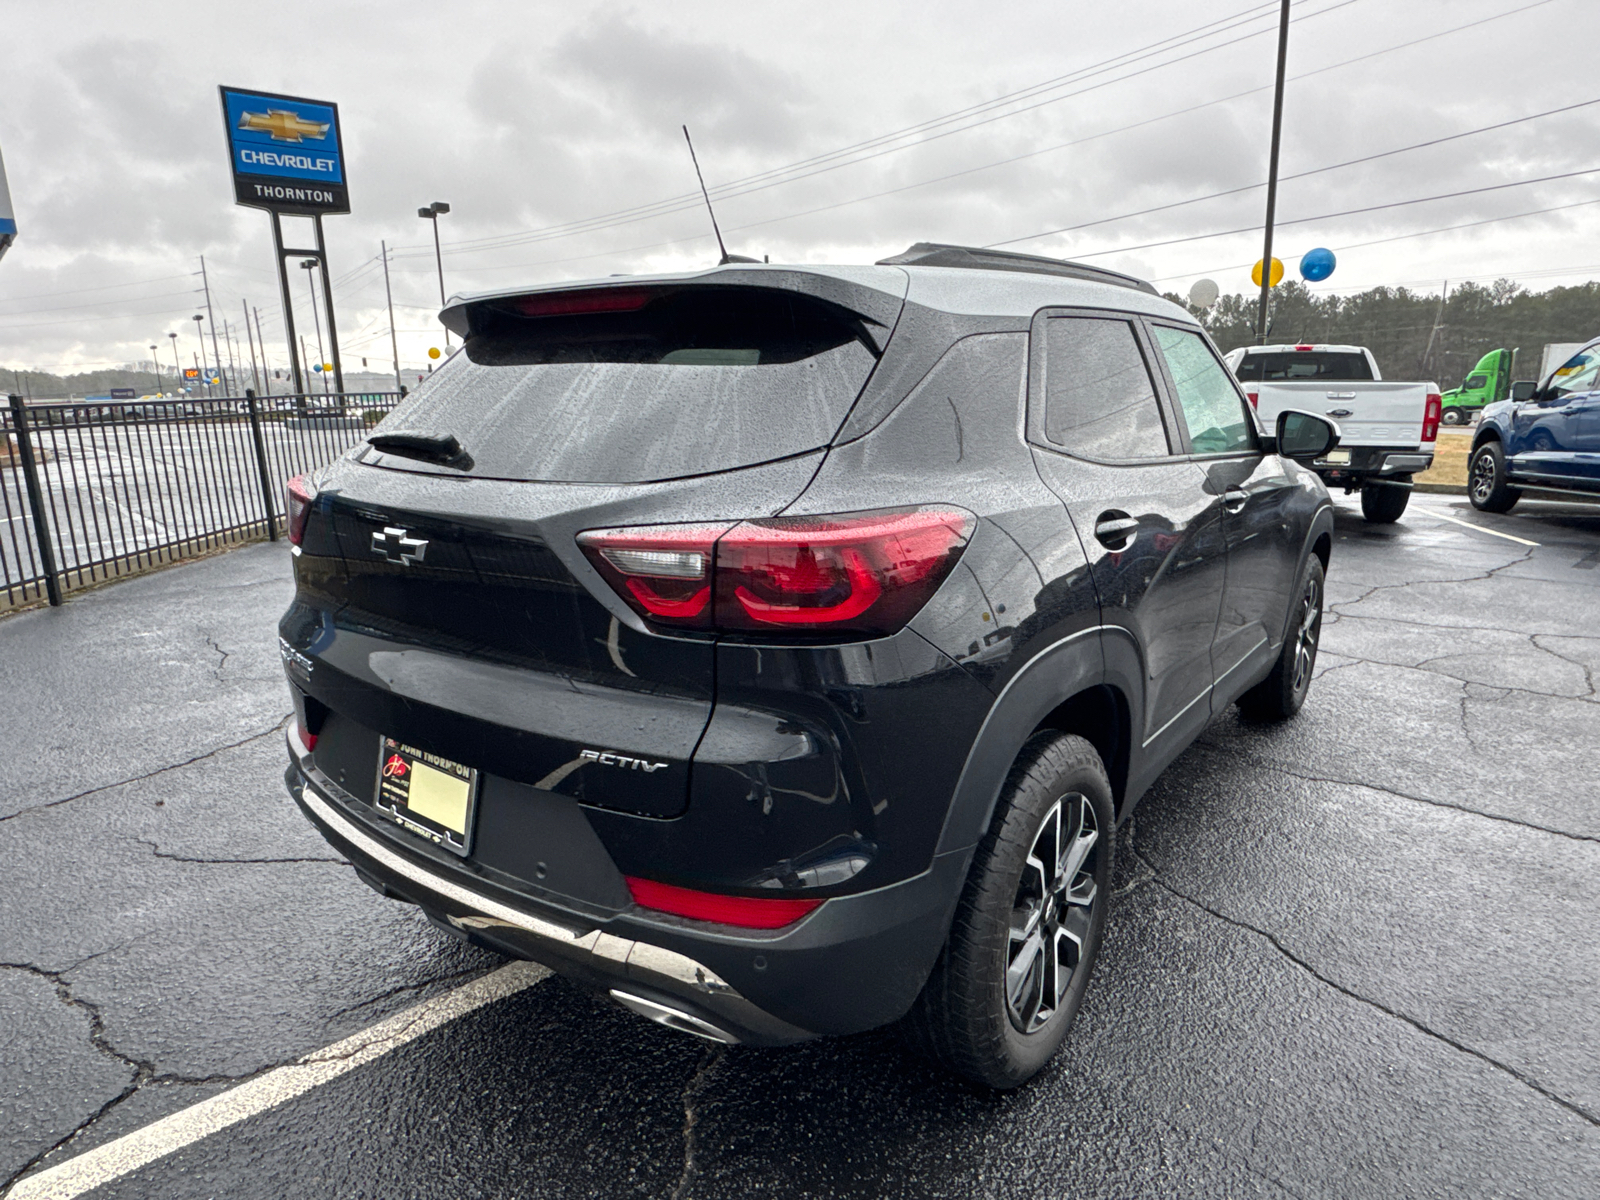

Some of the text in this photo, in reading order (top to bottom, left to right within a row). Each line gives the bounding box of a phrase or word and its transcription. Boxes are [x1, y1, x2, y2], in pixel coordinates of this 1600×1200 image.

[241, 149, 334, 171] CHEVROLET
[254, 184, 333, 203] THORNTON
[580, 750, 668, 772] ACTIV
[404, 820, 432, 838] CHEVROLET
